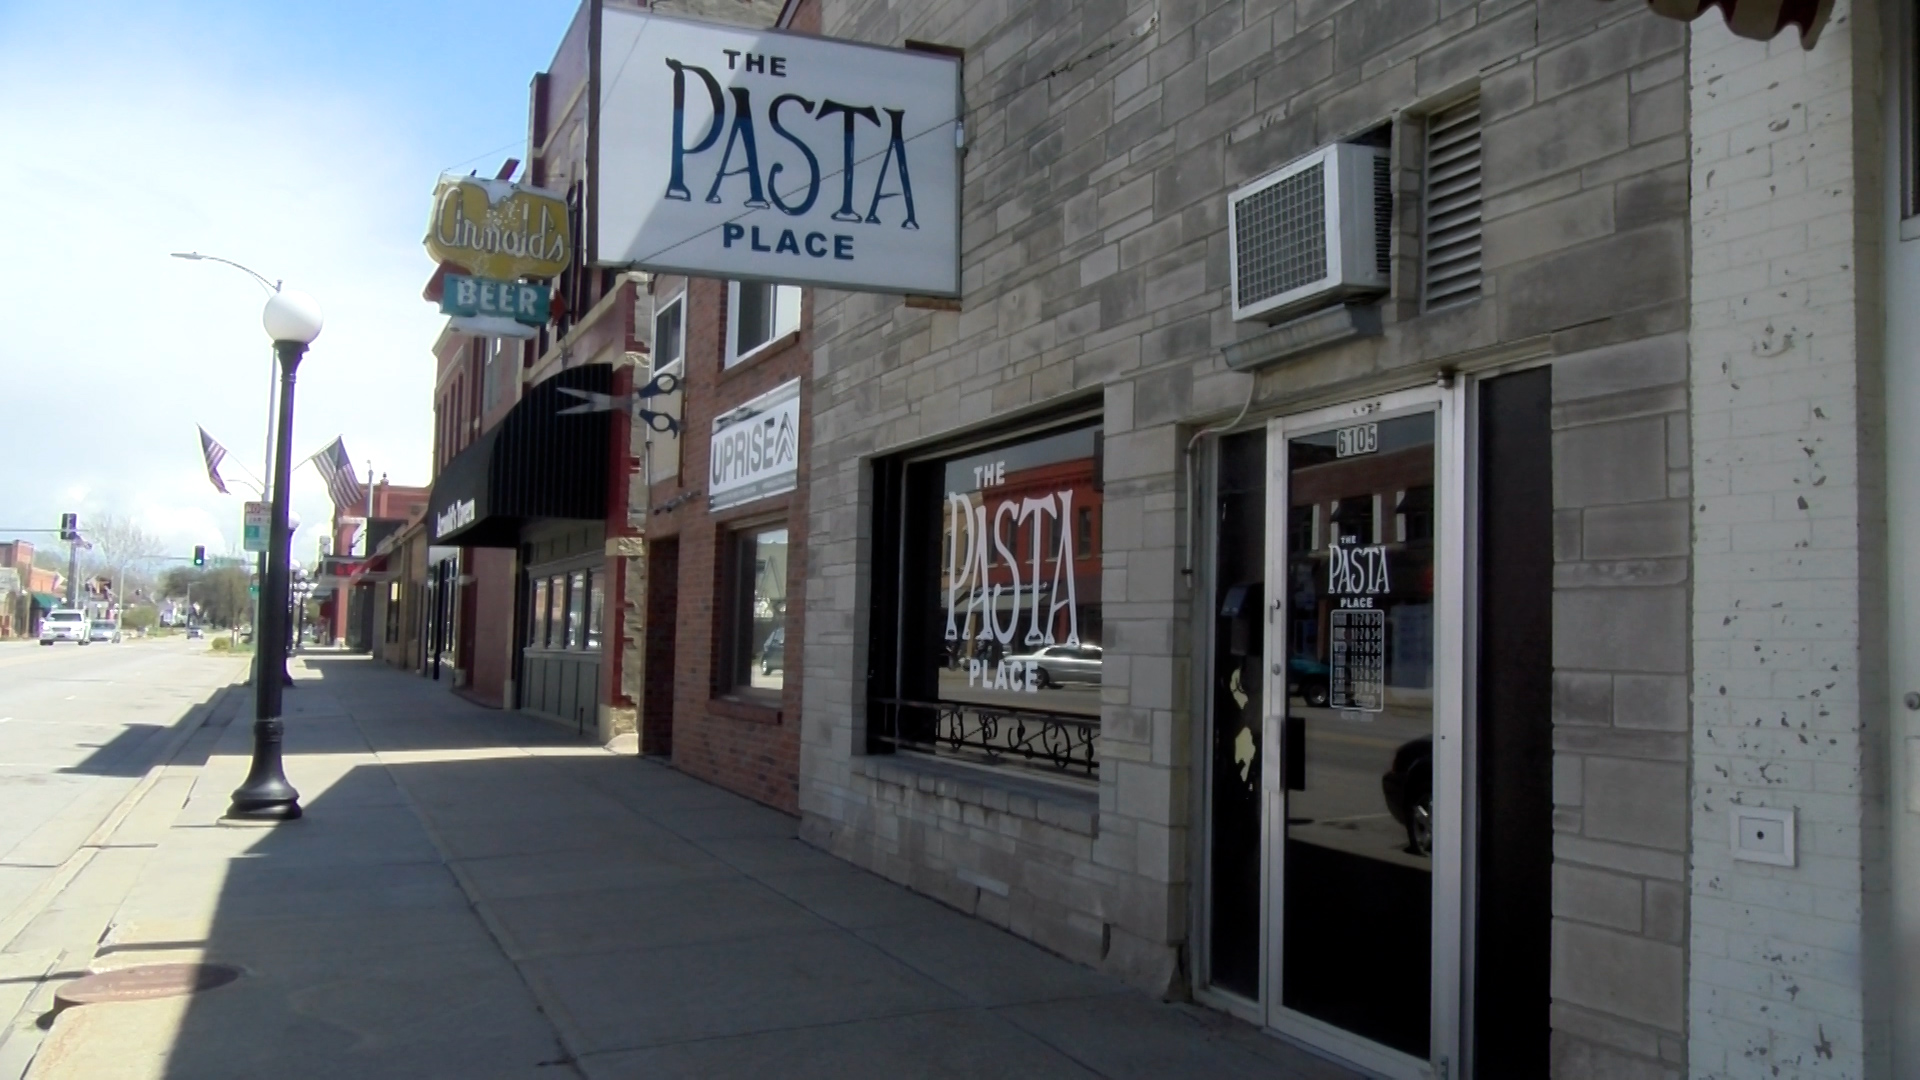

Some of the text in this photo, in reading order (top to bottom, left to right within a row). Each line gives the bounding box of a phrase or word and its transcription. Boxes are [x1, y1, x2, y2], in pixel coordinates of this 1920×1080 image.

[723, 49, 788, 78] THE
[665, 57, 920, 230] PASTA
[723, 222, 855, 260] PLACE
[457, 279, 539, 316] BEER
[1338, 425, 1376, 454] 6105
[973, 461, 1006, 488] THE
[1340, 535, 1356, 544] THE
[945, 489, 1080, 647] PASTA
[1328, 543, 1390, 594] PASTA
[1340, 597, 1374, 608] PLACE
[969, 659, 1039, 693] PLACE
